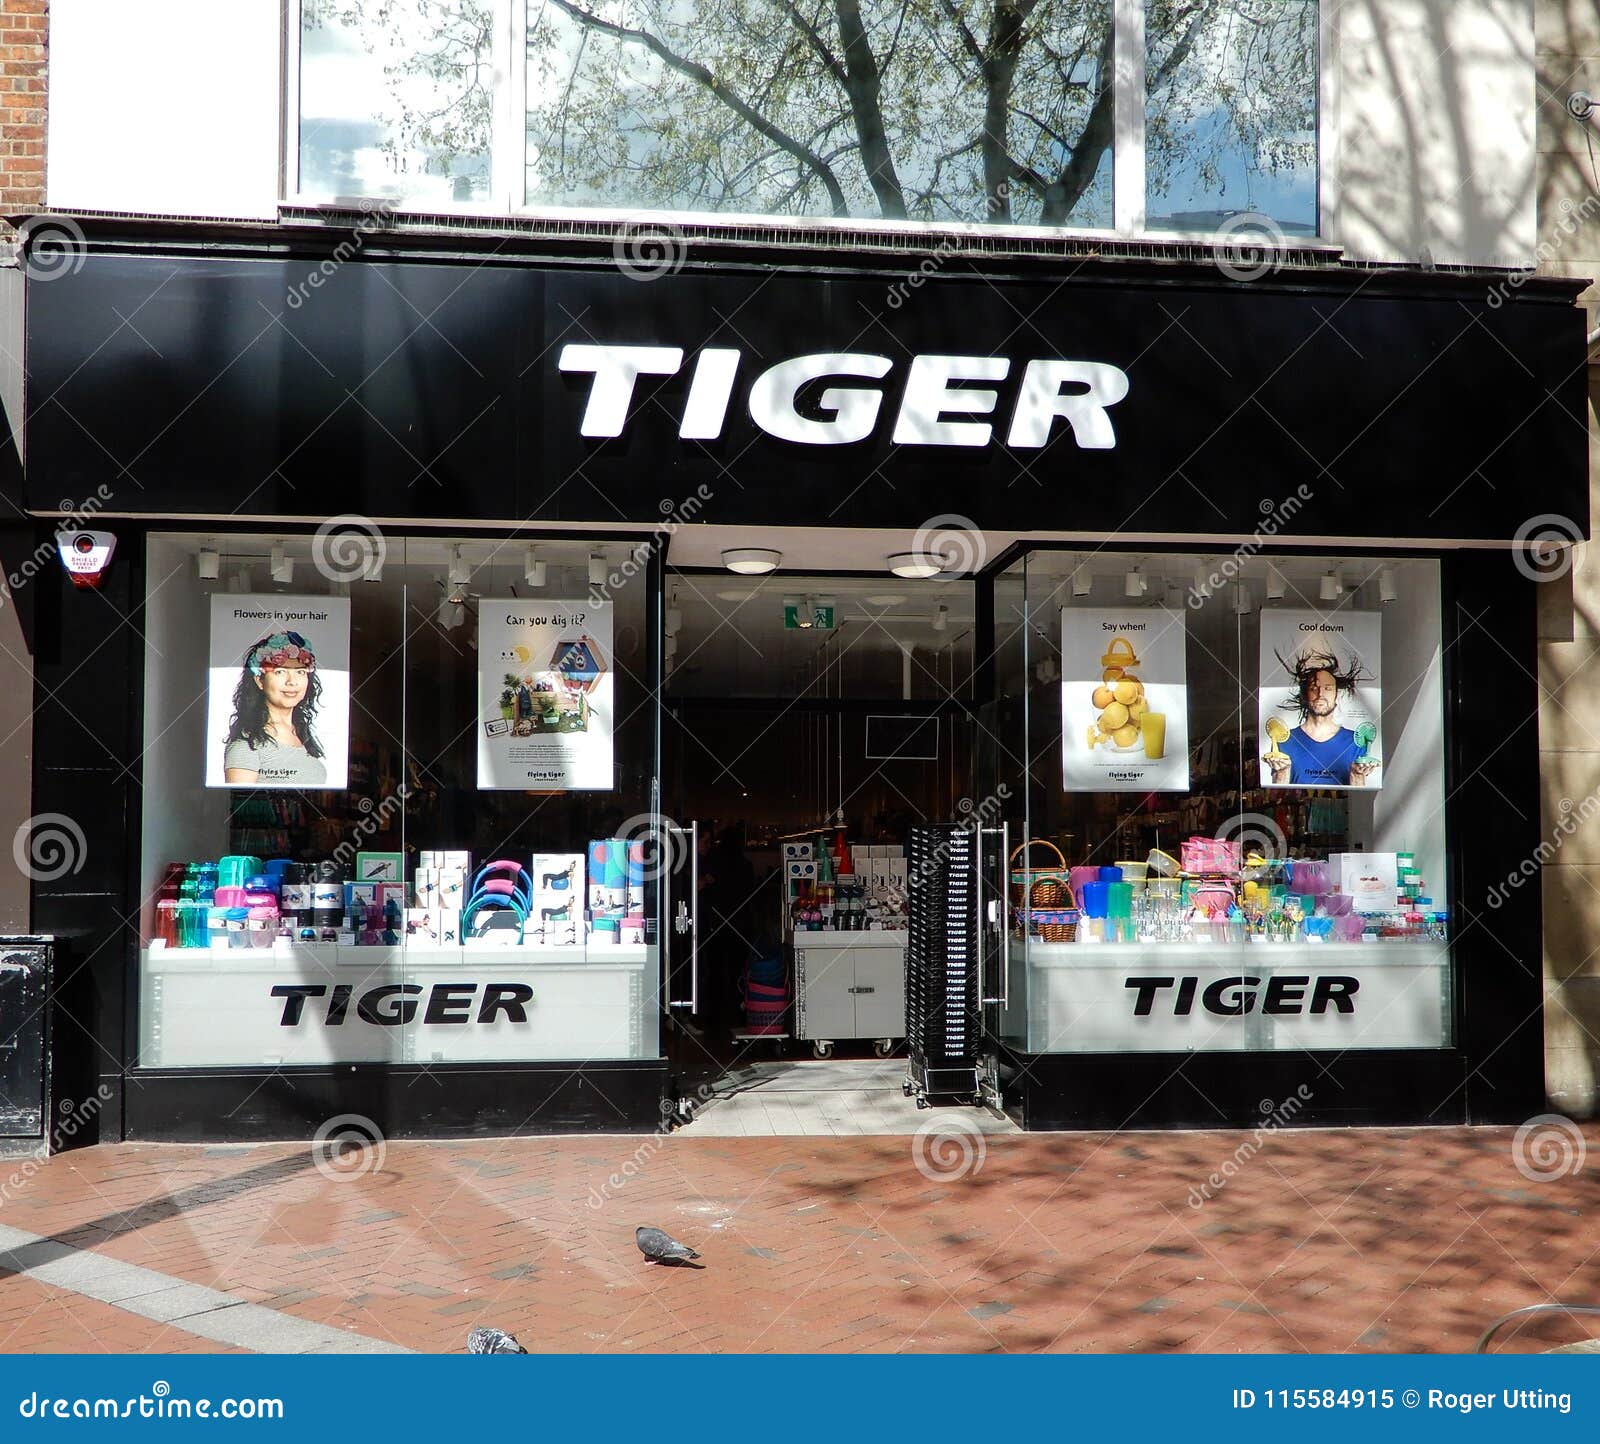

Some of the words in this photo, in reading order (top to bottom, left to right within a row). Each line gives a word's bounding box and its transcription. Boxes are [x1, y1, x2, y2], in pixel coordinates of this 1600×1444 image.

[558, 343, 1130, 449] TIGER
[233, 609, 273, 619] Flowers
[274, 611, 283, 619] in
[285, 612, 307, 622] your
[309, 611, 328, 620] hair
[506, 614, 525, 625] Can
[529, 616, 548, 627] you
[551, 614, 567, 628] dig
[571, 614, 586, 626] it?
[1102, 622, 1118, 632] Say
[1119, 622, 1146, 631] when!
[1298, 623, 1318, 631] Cool
[1319, 623, 1344, 632] down
[1124, 975, 1361, 1016] TIGER
[270, 983, 534, 1026] TIGER
